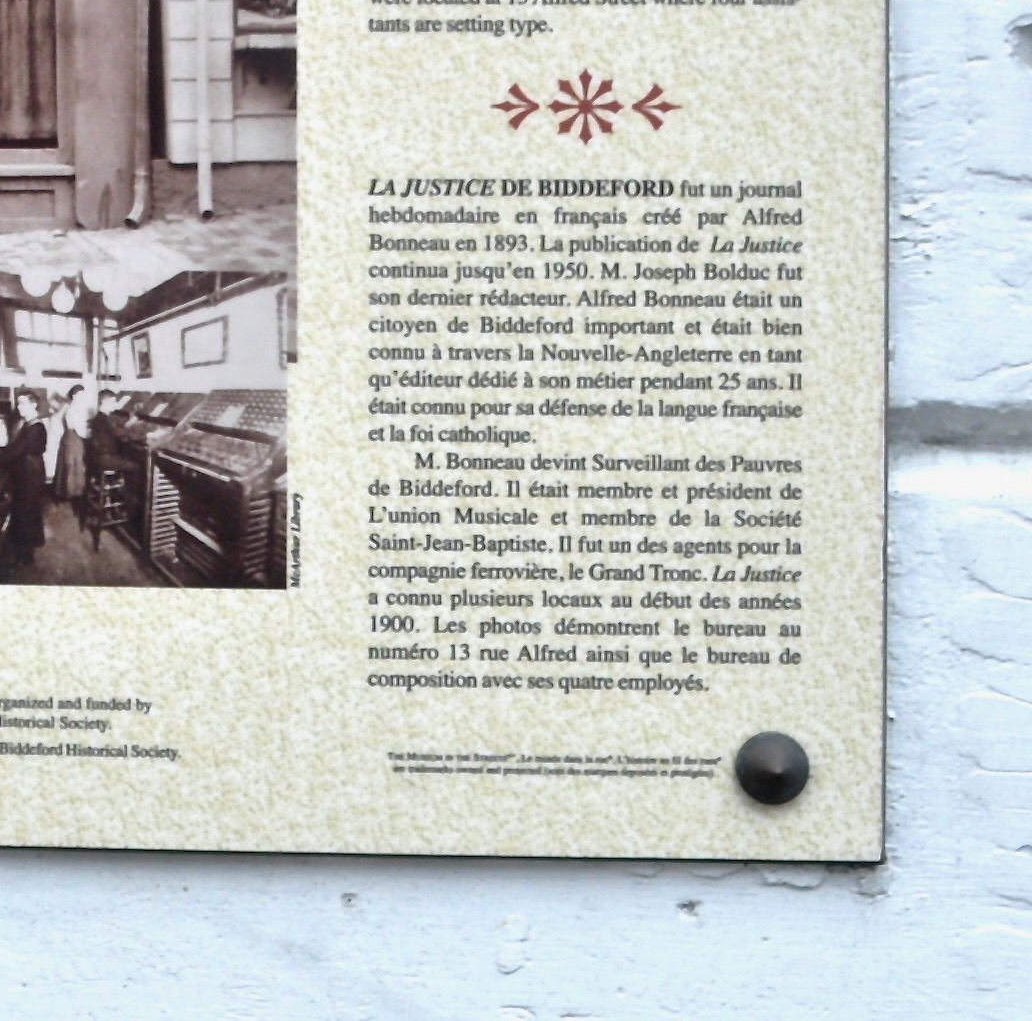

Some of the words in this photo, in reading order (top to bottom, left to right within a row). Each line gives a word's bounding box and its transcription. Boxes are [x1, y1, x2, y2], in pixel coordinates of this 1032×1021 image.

[368, 18, 411, 33] tants
[414, 19, 443, 33] are
[446, 15, 505, 37] setting
[508, 18, 553, 37] type.
[368, 178, 396, 196] LA
[400, 178, 496, 198] JUSTICE
[500, 178, 533, 197] DE
[538, 178, 675, 199] BIDDEFORD
[679, 180, 705, 199] fut
[710, 185, 733, 198] un
[736, 180, 802, 202] journal
[368, 206, 500, 224] hebdomadaire
[514, 211, 538, 224] en
[554, 207, 627, 229] français
[641, 208, 681, 225] créé
[697, 212, 728, 229] par
[742, 208, 803, 226] Alfred
[368, 233, 450, 252] Bonneau
[455, 238, 477, 252] en
[484, 234, 534, 252] 1893.
[539, 235, 564, 253] La
[568, 235, 672, 256] publication
[676, 236, 700, 253] de
[710, 235, 734, 253] La
[739, 235, 803, 254] Justice
[415, 451, 440, 470] M.
[446, 452, 525, 471] Bonneau
[530, 453, 587, 471] devint
[592, 454, 690, 472] Surveillant
[695, 455, 726, 472] des
[730, 455, 802, 474] Pauvres
[370, 613, 420, 633] 1900.
[433, 616, 467, 634] Les
[479, 617, 541, 638] photos
[554, 617, 661, 636] démontrent
[673, 618, 690, 636] le
[702, 619, 766, 637] bureau
[778, 624, 801, 638] au
[366, 670, 477, 692] composition
[482, 675, 523, 689] avec
[527, 676, 555, 689] ses
[558, 675, 615, 693] quatre
[616, 668, 709, 694] employés.
[58, 697, 82, 710] and
[86, 697, 131, 711] funded
[134, 698, 152, 715] by
[58, 716, 112, 733] Society.
[0, 742, 62, 756] Biddeford
[66, 744, 127, 758] Historical
[131, 745, 181, 761] Society.
